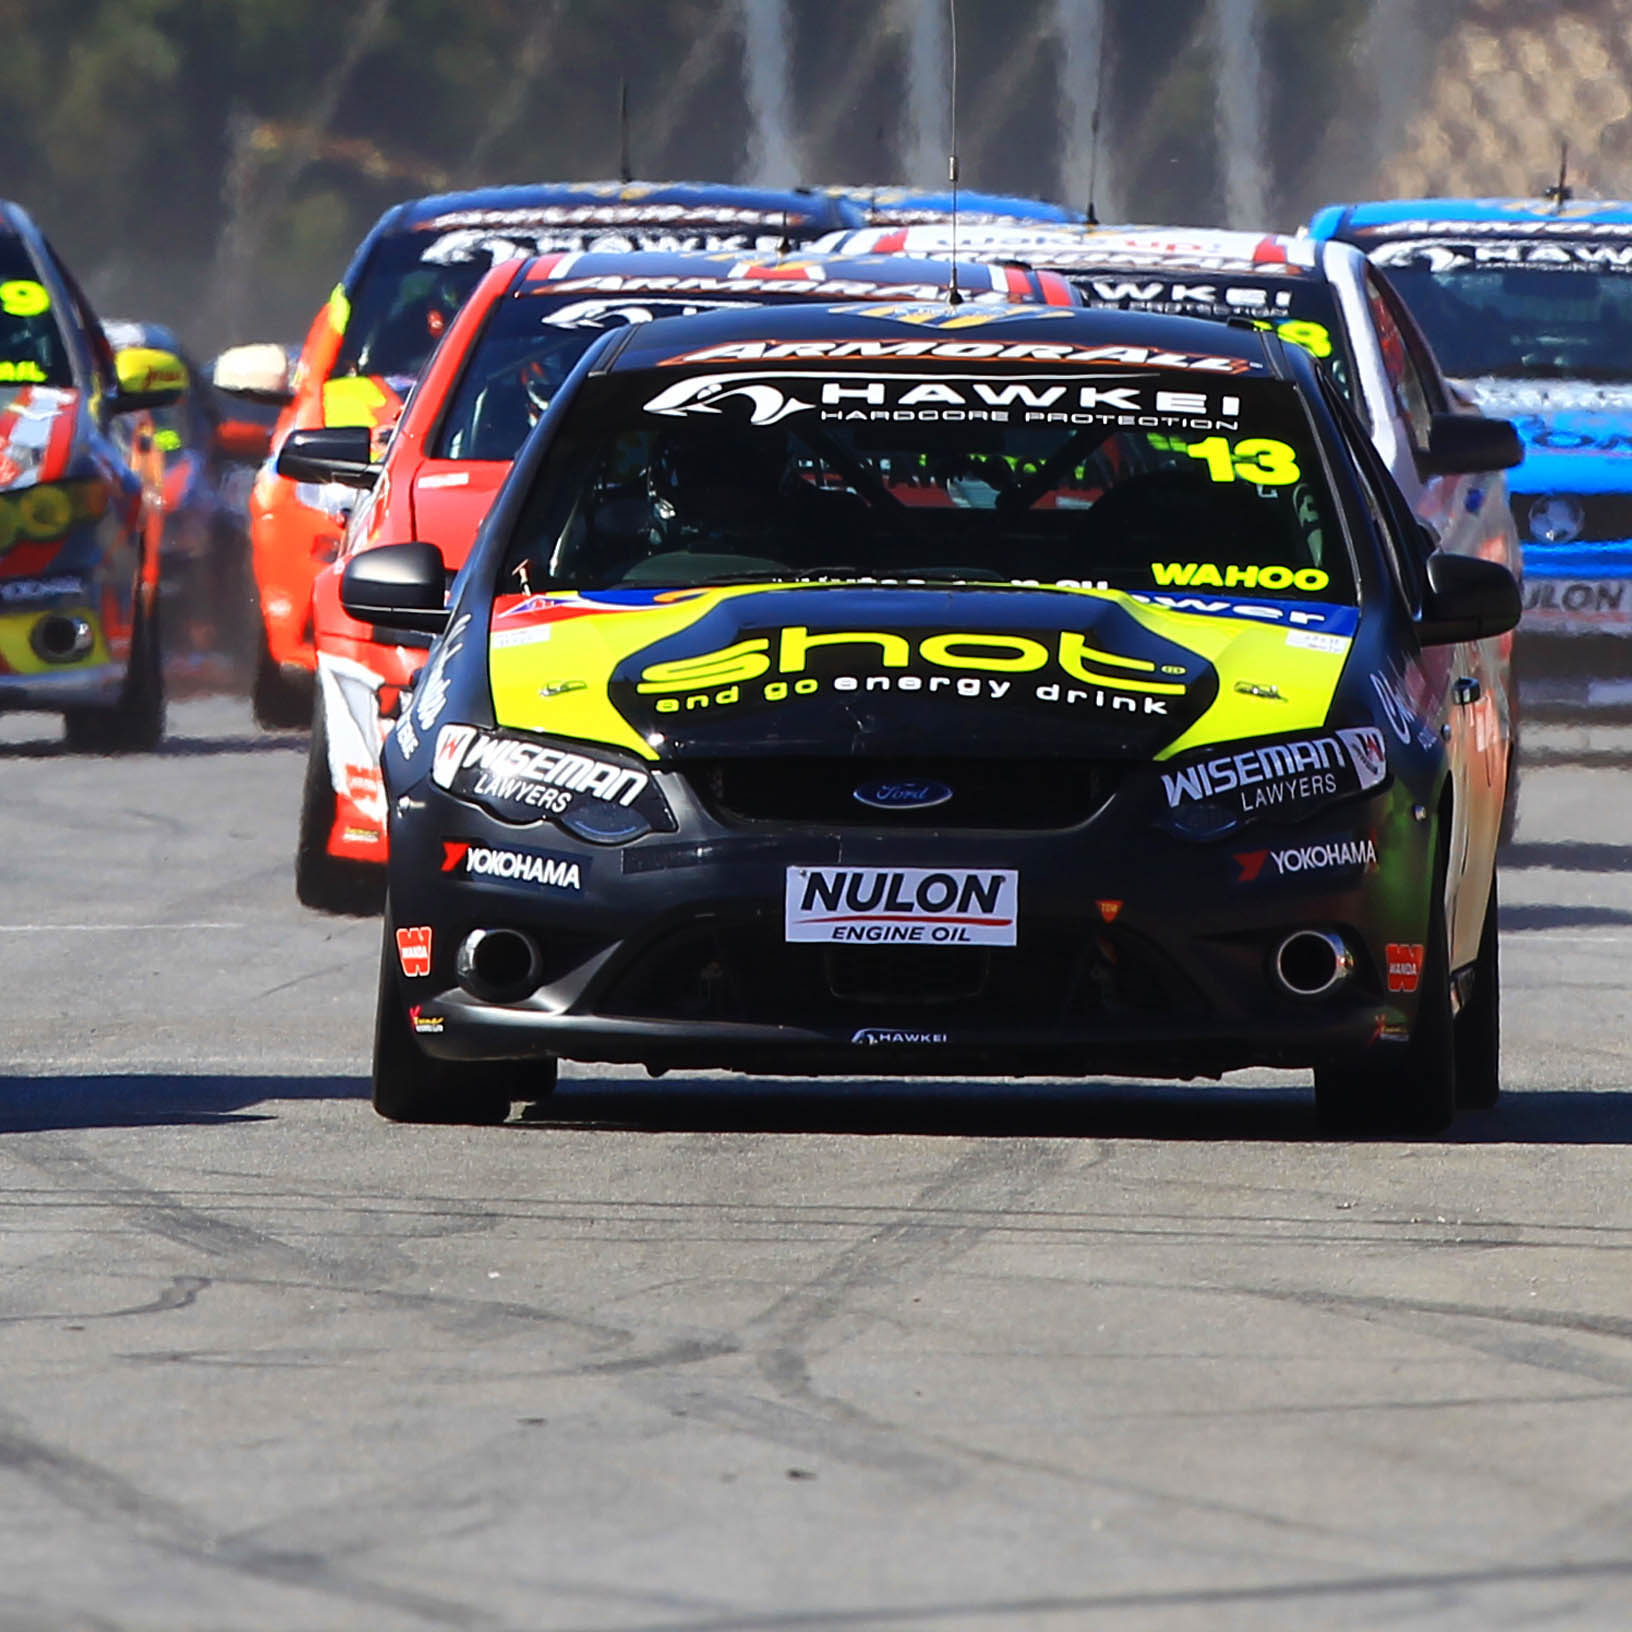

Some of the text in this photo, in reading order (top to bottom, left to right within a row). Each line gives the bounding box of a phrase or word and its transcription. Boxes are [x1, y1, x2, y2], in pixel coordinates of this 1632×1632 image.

[821, 383, 1240, 416] HAWKEI
[821, 410, 1239, 431] HARDCORE PROTECTION
[1187, 435, 1300, 486] 13
[1151, 562, 1330, 592] WAHOO
[637, 626, 1186, 696] shot
[655, 674, 1170, 715] and go energy drink
[463, 734, 650, 808] WISEMAN
[1162, 738, 1346, 808] WISEMAN
[474, 774, 573, 815] LAWYERS
[1241, 773, 1337, 811] LAWYERS
[466, 849, 581, 889] YOKOHAMA
[1271, 839, 1377, 874] YOKOHAMA
[801, 870, 1003, 914] NULON
[832, 925, 971, 942] ENGINE OIL
[879, 1032, 948, 1044] HAWKEI
